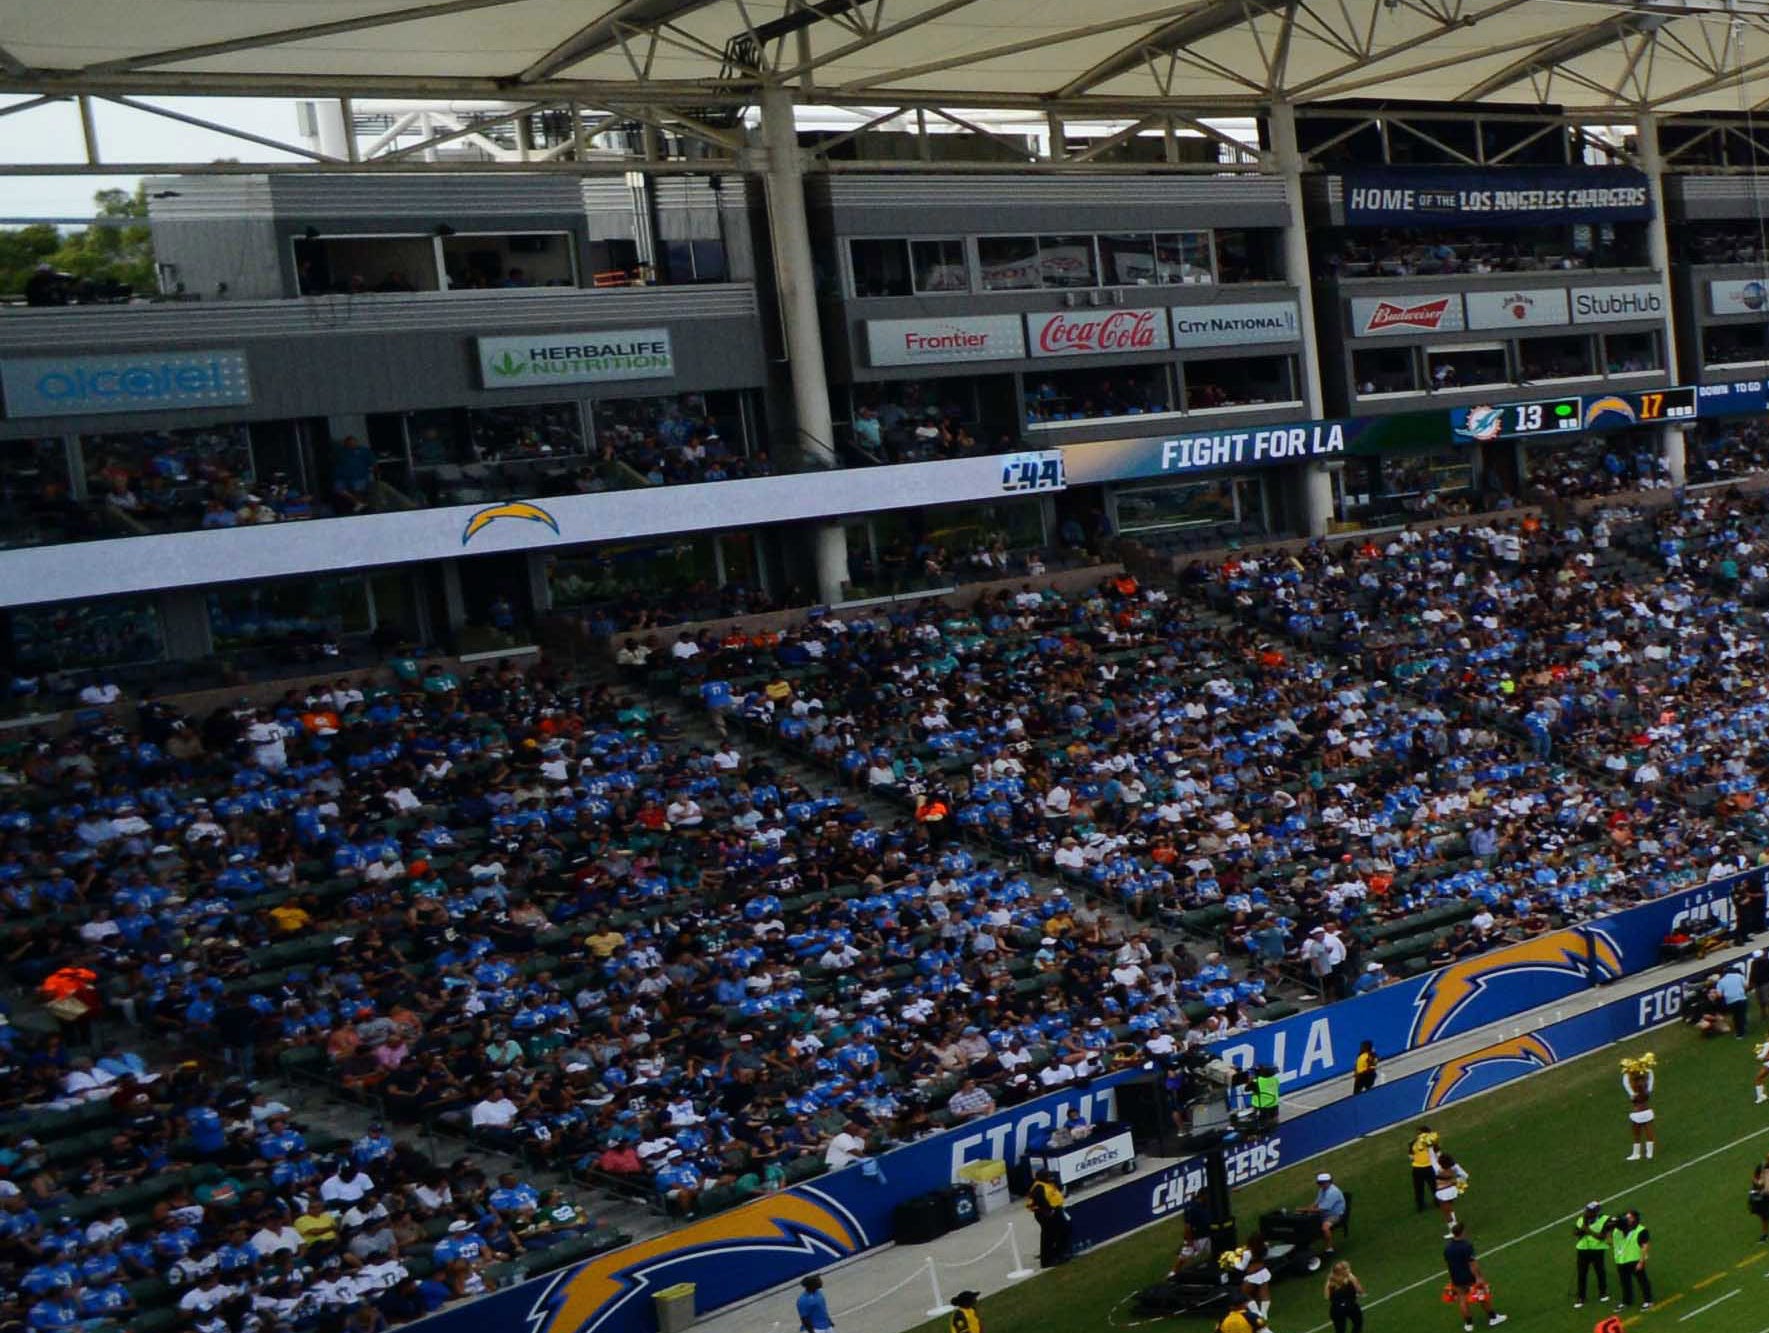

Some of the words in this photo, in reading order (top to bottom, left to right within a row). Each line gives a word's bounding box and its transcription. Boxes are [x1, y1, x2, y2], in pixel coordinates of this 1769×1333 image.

[1351, 188, 1415, 210] HOME
[1419, 194, 1435, 207] OF
[1437, 193, 1456, 208] THE
[1460, 189, 1491, 211] LOS
[1494, 189, 1565, 210] ANGELES
[1567, 187, 1646, 209] CHARGERS
[1371, 303, 1444, 326] Budweiser
[1576, 292, 1661, 315] StubHub
[1178, 320, 1209, 334] CITY
[1211, 317, 1284, 332] NATIONAL
[529, 341, 667, 361] HERBALIFE
[905, 331, 989, 349] Frontier
[530, 354, 671, 376] NUTRITION
[36, 363, 222, 401] alcatel
[1516, 405, 1543, 431] 13
[1640, 394, 1663, 419] 17
[1162, 431, 1247, 470] FIGHT
[1254, 428, 1306, 460] FOR
[1312, 424, 1344, 454] LA
